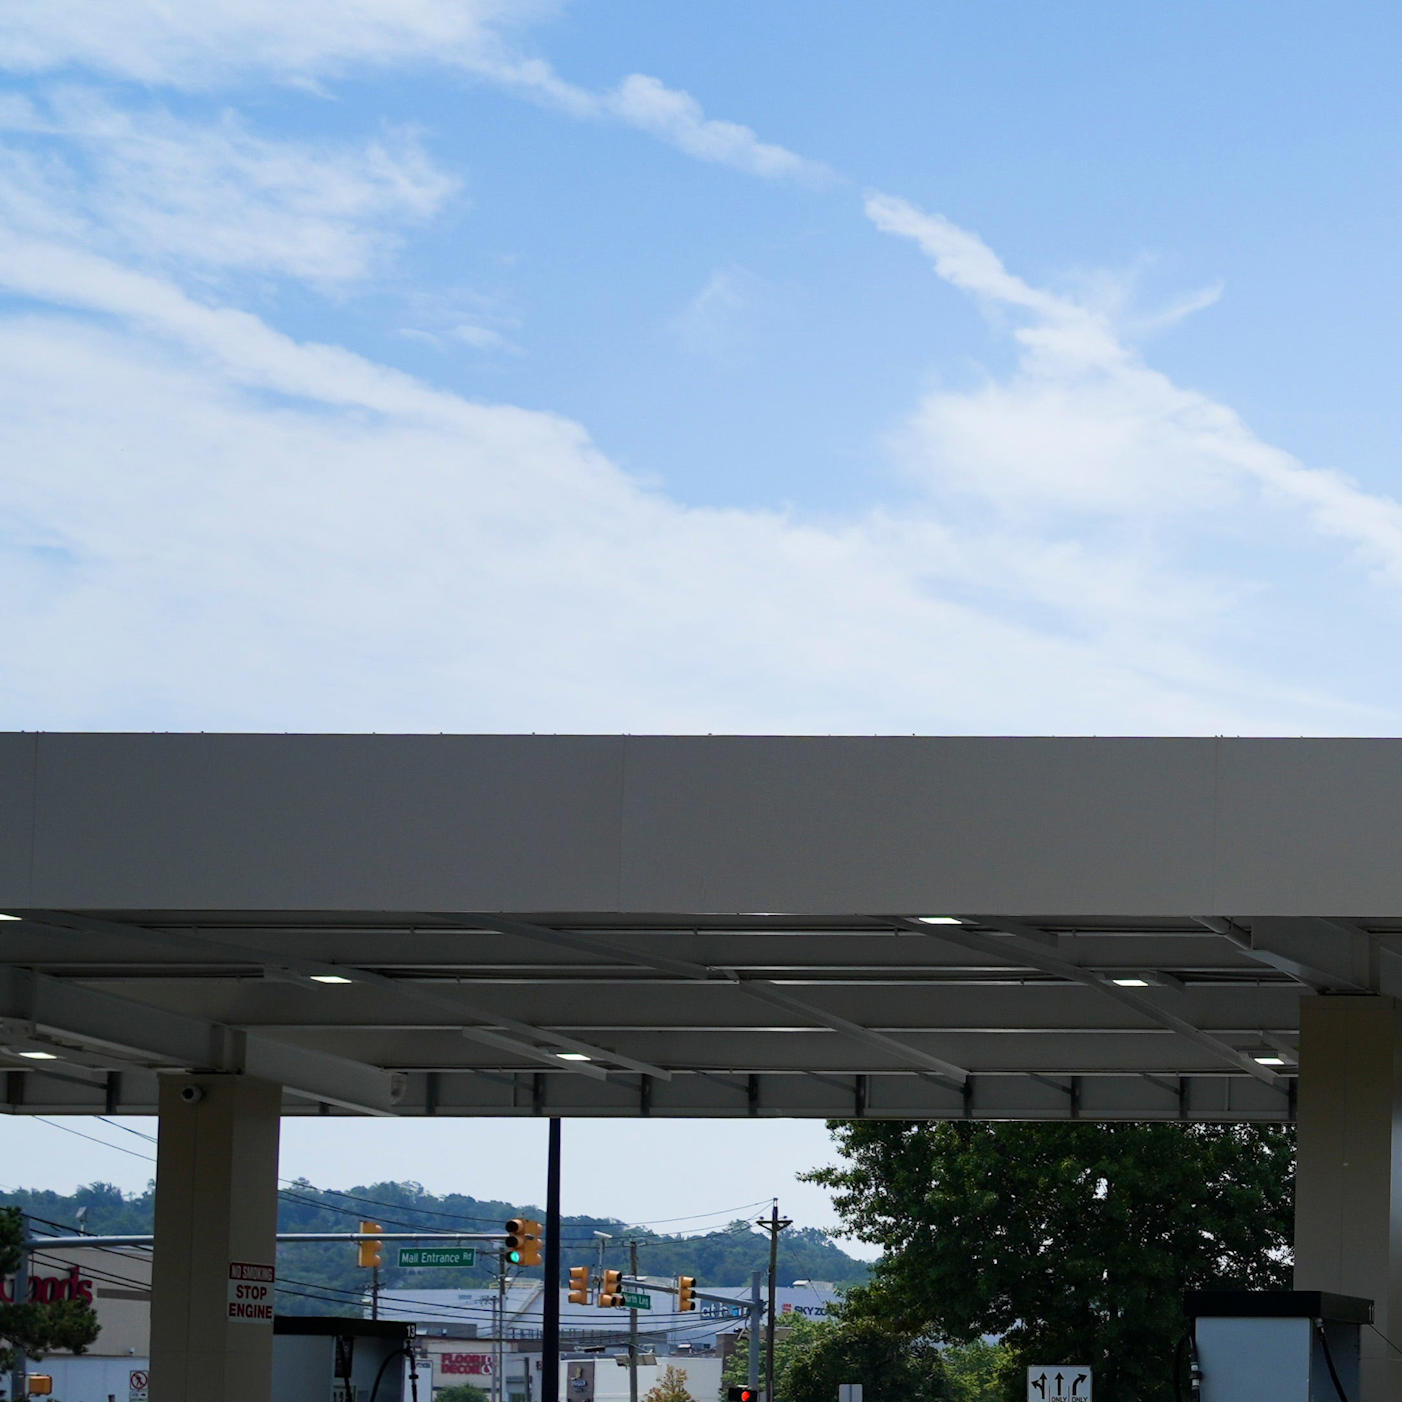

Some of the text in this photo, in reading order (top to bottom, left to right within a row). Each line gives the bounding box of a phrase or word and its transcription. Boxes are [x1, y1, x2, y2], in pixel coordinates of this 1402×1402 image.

[401, 1252, 472, 1263] Mall Entrance Rd
[236, 1284, 267, 1299] STOP
[229, 1303, 272, 1318] ENGINE
[794, 1306, 813, 1315] SKY
[406, 1325, 416, 1337] 13
[441, 1353, 487, 1364] FLOOR
[441, 1364, 482, 1374] DECOR
